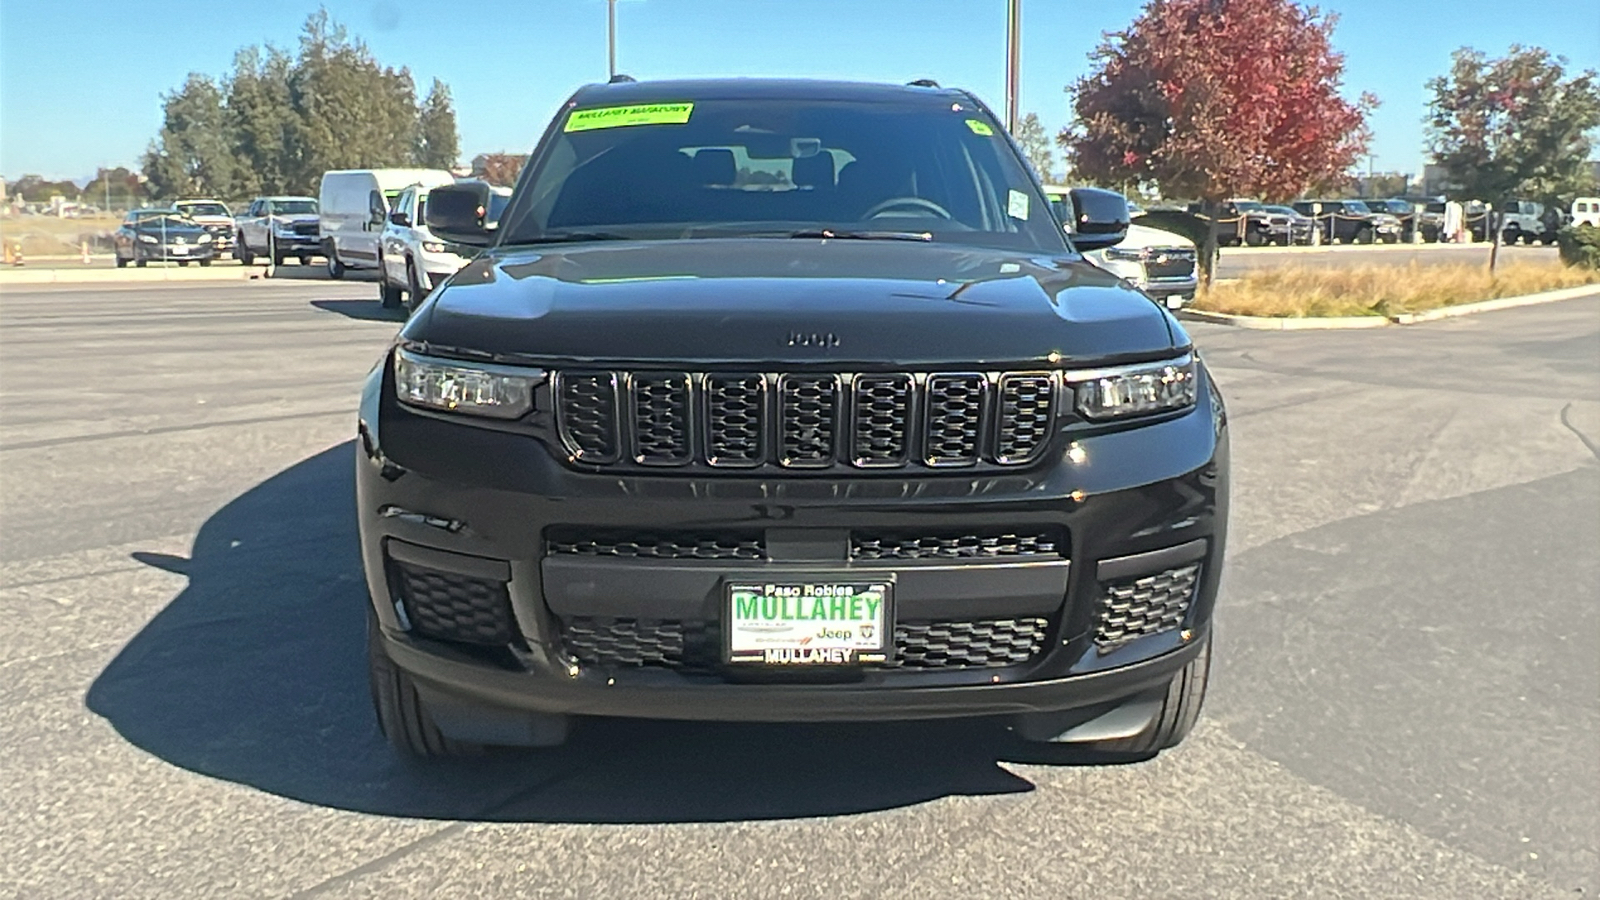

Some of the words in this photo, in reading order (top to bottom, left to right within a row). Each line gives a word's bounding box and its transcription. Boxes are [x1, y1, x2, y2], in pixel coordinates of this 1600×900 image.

[765, 584, 801, 597] Paso
[804, 584, 854, 597] Robles
[736, 595, 882, 621] MULLAHEY
[816, 627, 852, 641] Jeep
[765, 648, 853, 664] MULLAHEY
